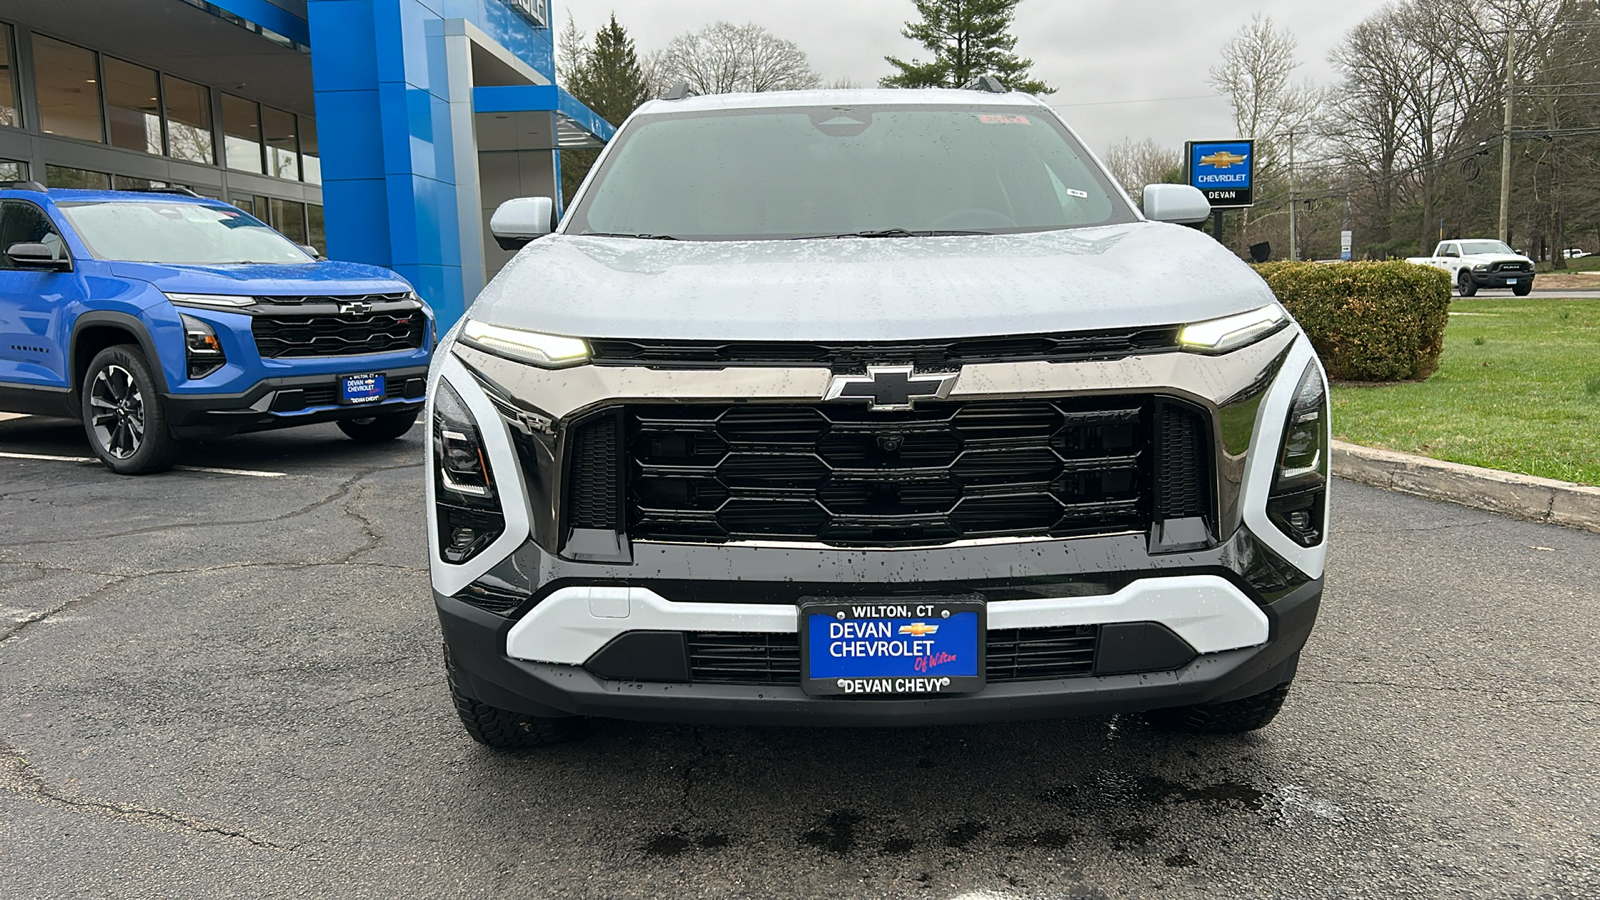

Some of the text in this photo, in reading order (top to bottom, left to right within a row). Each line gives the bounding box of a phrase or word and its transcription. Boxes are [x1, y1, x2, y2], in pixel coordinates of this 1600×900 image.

[1198, 174, 1246, 183] CHEVROLET
[1208, 191, 1236, 199] DEVAN
[347, 385, 375, 393] CHEVROLET
[852, 605, 935, 618] WILTON, CT
[829, 622, 892, 639] DEVAN
[829, 640, 935, 658] CHEVROLET
[914, 652, 957, 673] Of Wilton
[844, 678, 943, 693] DEVAN CHEVY
